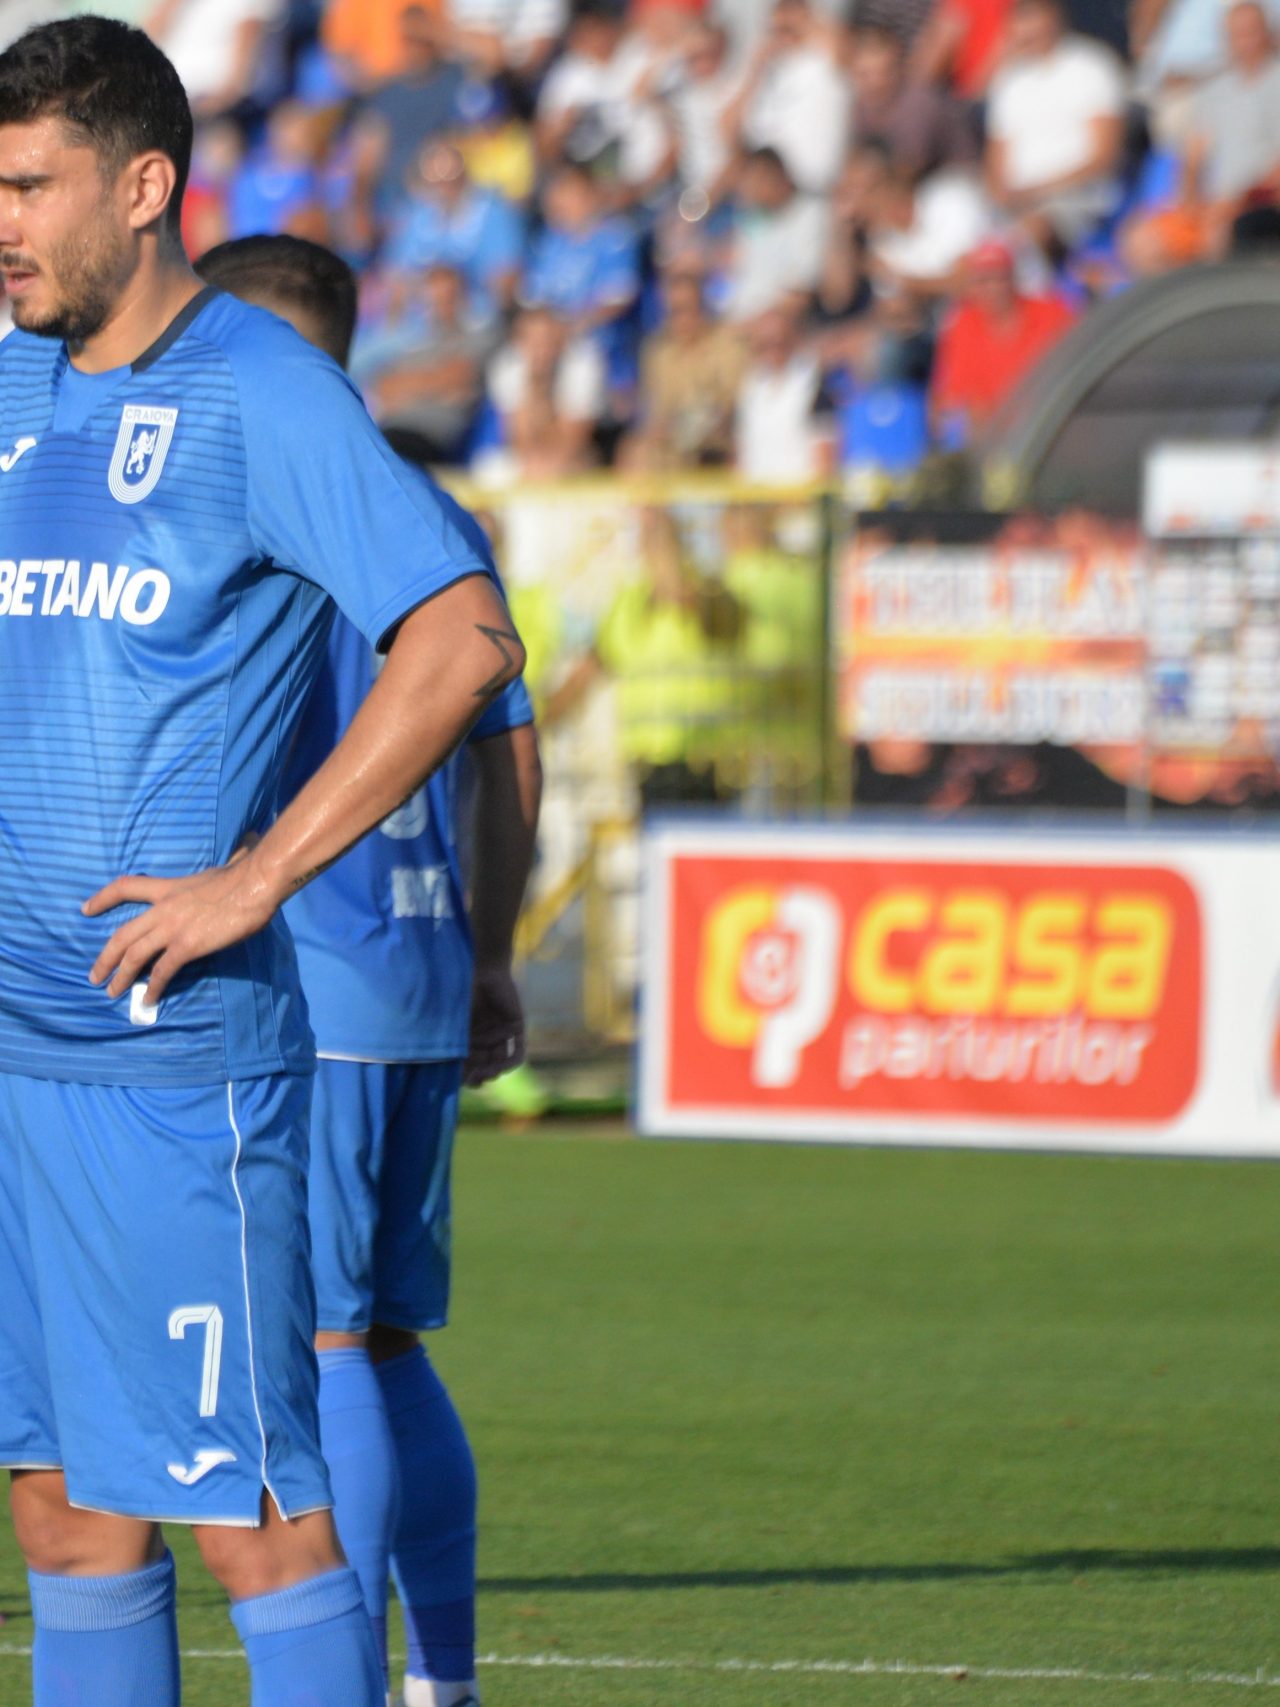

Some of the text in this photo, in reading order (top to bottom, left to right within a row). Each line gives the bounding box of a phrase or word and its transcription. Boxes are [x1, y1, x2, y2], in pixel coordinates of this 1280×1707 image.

[850, 893, 1172, 1017] casa
[841, 1015, 1152, 1088] pariurilor
[168, 1305, 223, 1417] 7
